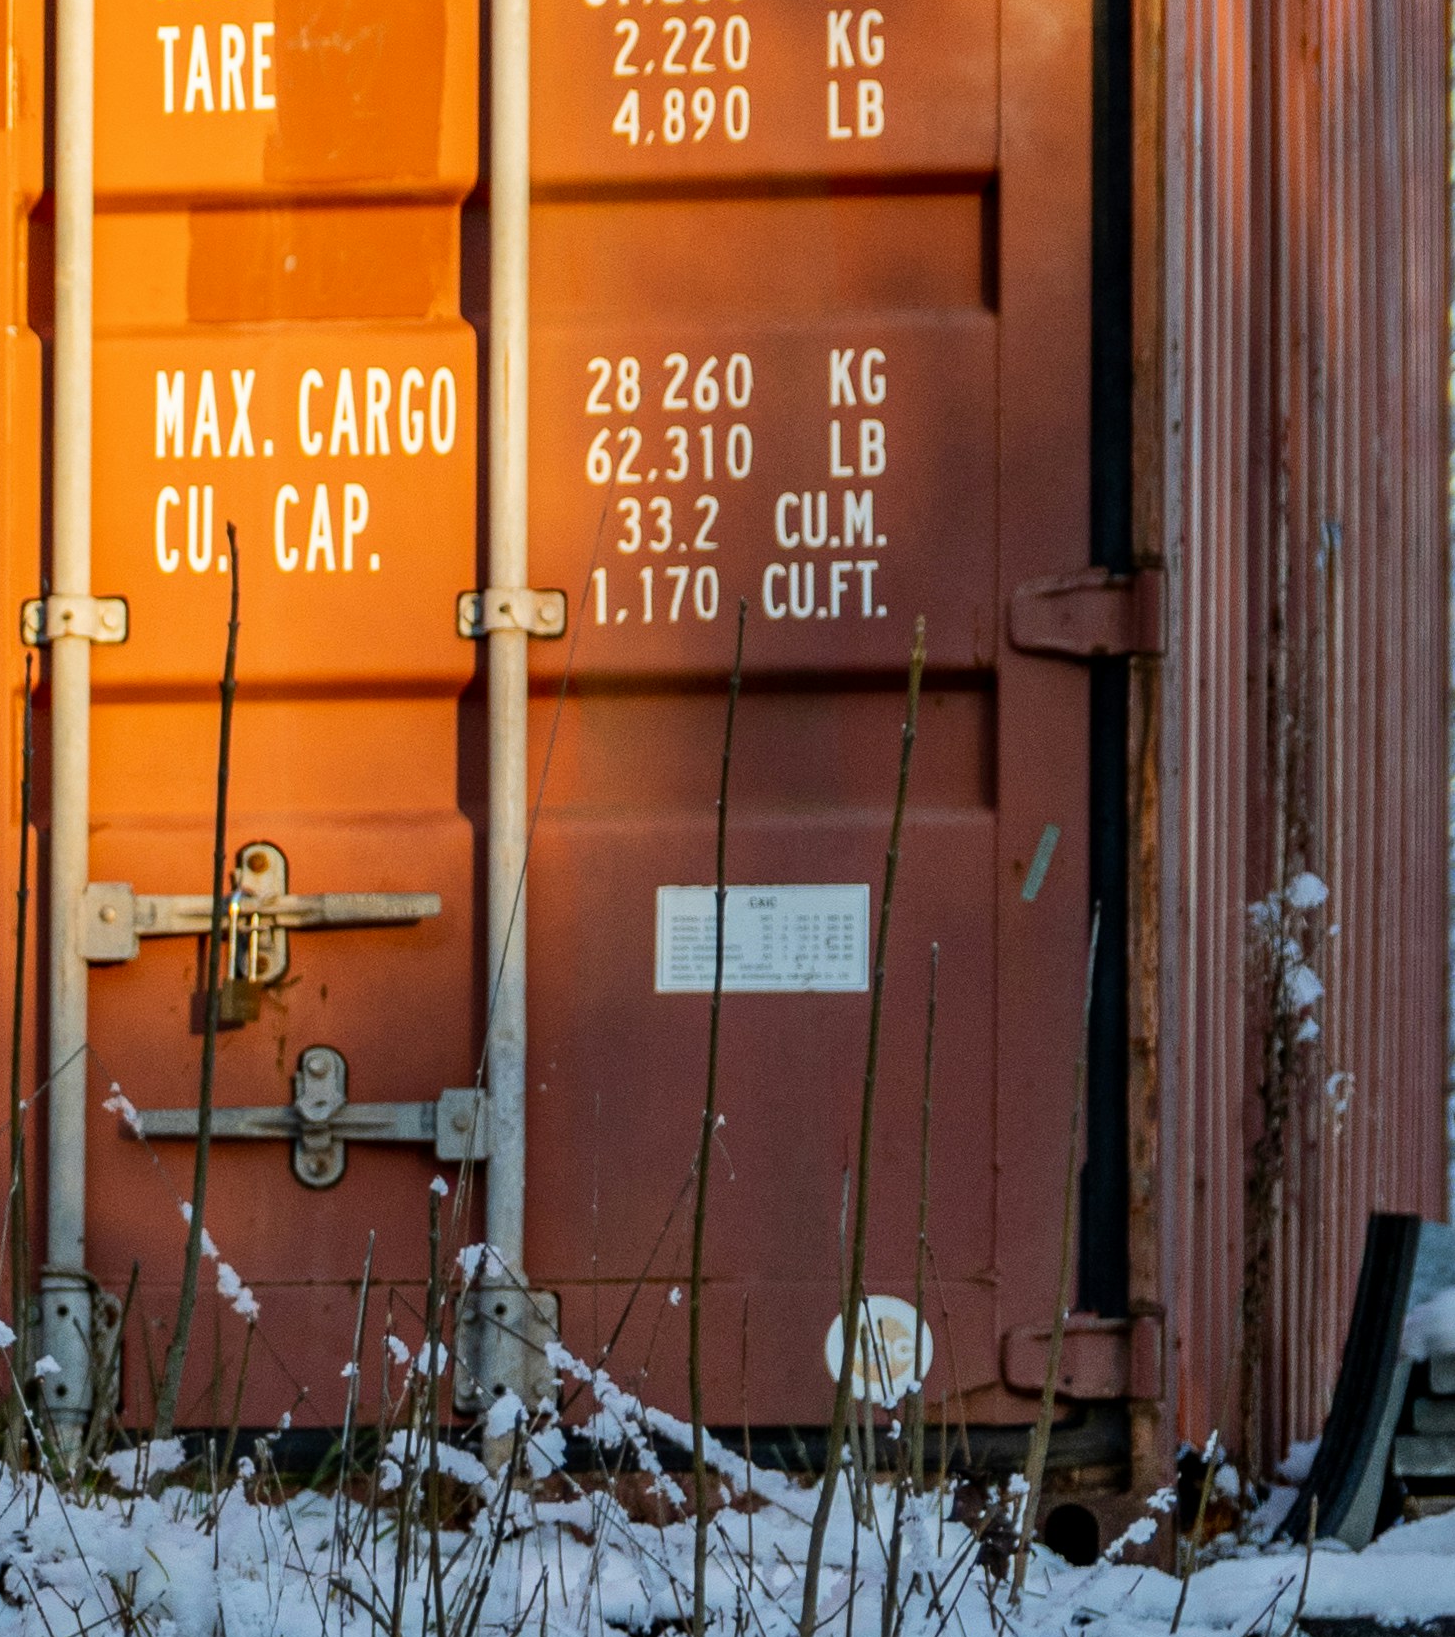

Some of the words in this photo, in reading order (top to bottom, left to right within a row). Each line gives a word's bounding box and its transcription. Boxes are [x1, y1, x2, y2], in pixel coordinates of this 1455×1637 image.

[157, 22, 276, 113] TARE
[613, 15, 751, 76] 2,220
[826, 9, 885, 69] KG
[612, 85, 751, 146] 4,890
[827, 79, 886, 139] LB
[829, 347, 887, 407] KG
[155, 369, 275, 458] MAX.
[299, 367, 456, 456] CARGO
[829, 418, 888, 478] LB
[155, 485, 228, 573] CU.
[274, 483, 381, 572] CAP.
[617, 494, 720, 554] 33.2
[774, 489, 888, 549] CU.M.
[761, 559, 889, 620] CU.FT.
